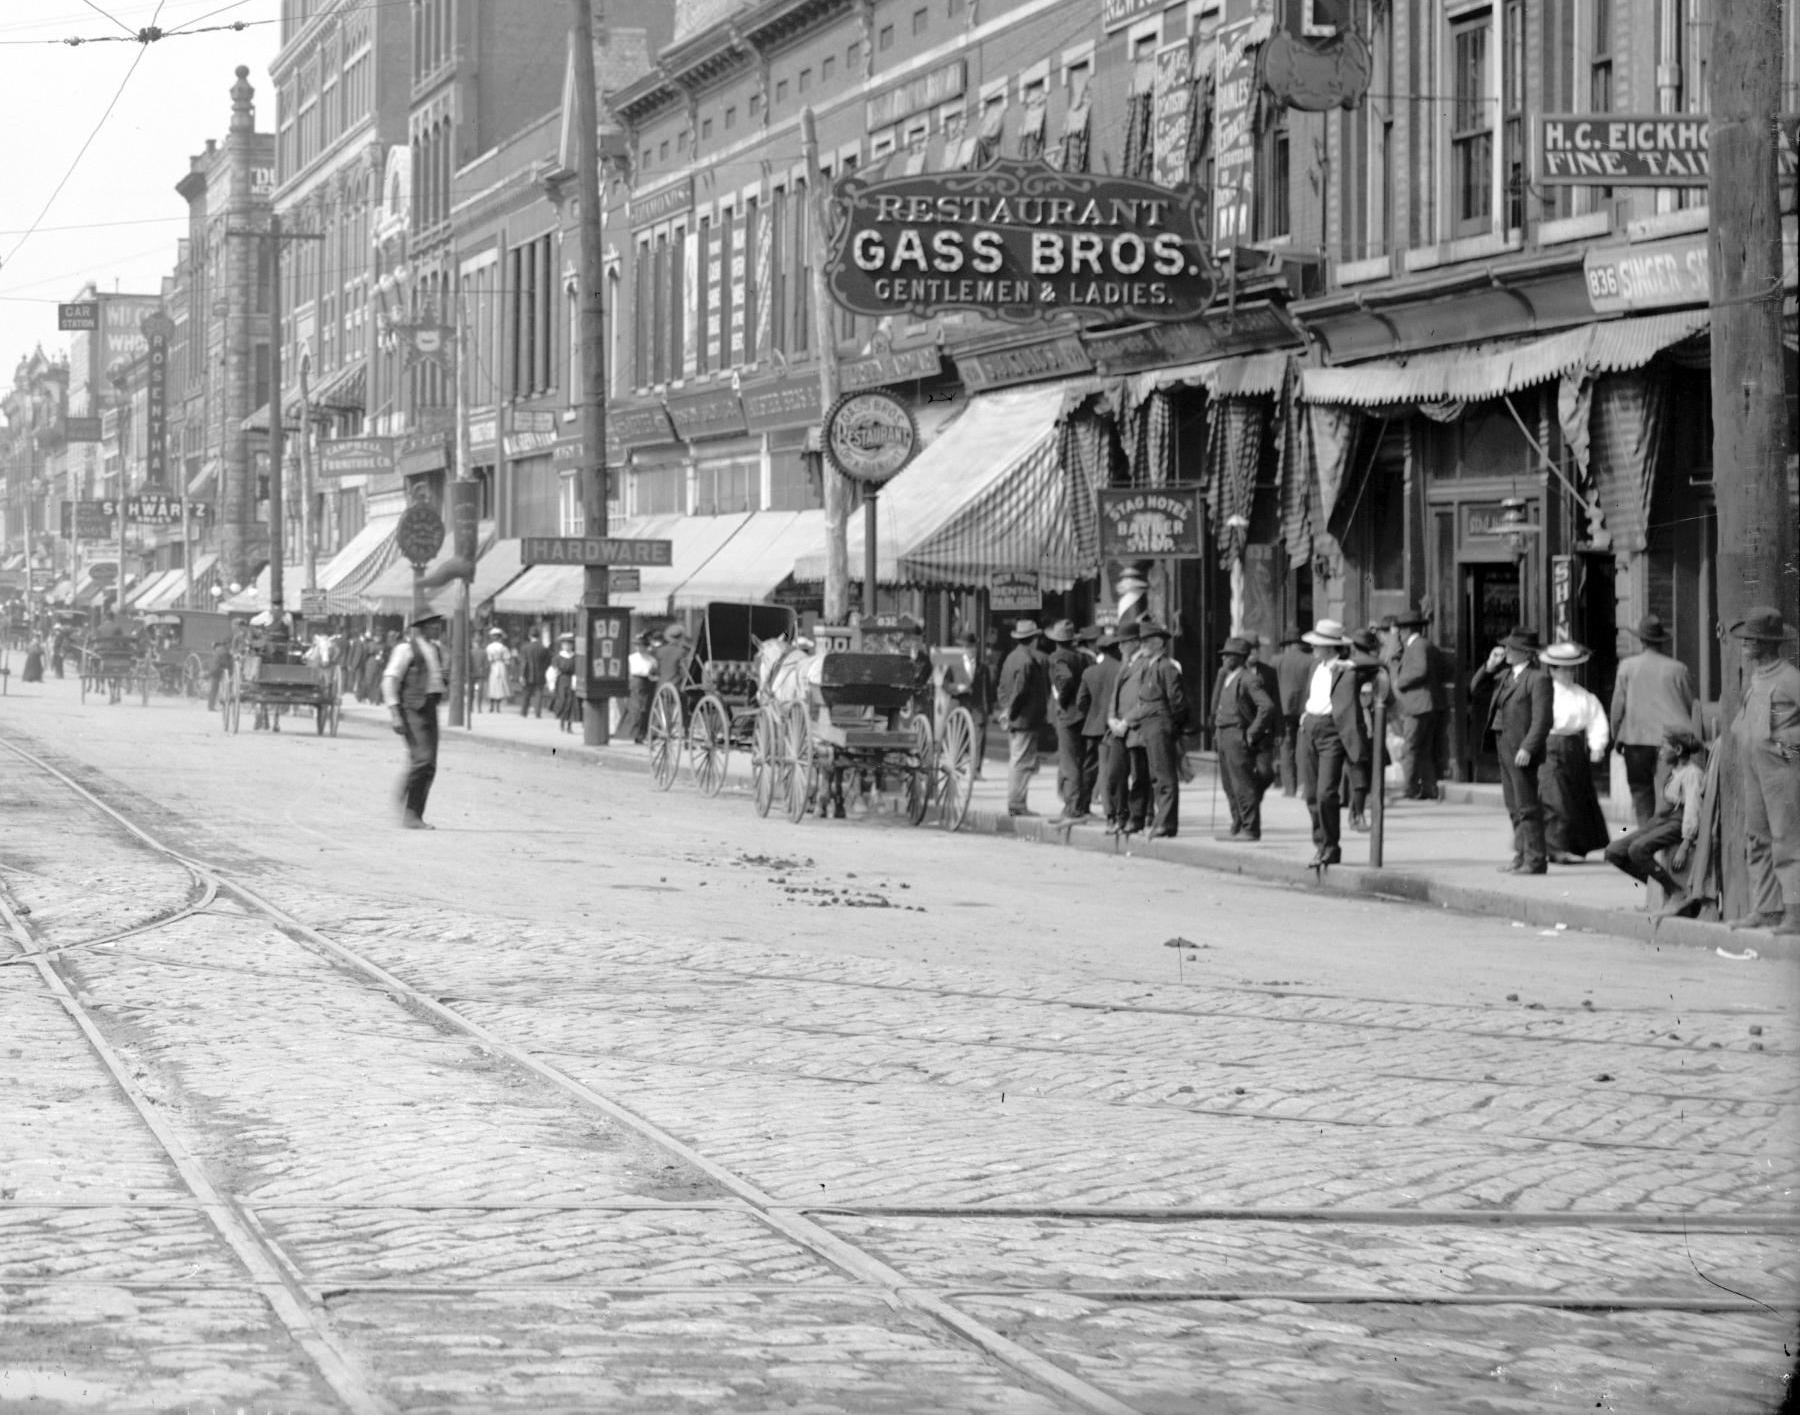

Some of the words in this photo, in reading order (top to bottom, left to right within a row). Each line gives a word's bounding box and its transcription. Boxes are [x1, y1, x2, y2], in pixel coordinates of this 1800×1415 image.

[1545, 151, 1628, 176] FINE
[875, 193, 1168, 226] RESTAURANT
[853, 228, 1004, 274] GASS
[1030, 231, 1199, 276] BROS.
[1588, 266, 1618, 298] 836
[1618, 253, 1681, 301] SINGER
[874, 278, 1029, 302] GENTLEMEN
[1039, 282, 1057, 303] &
[1069, 282, 1175, 305] LADIES.
[64, 305, 91, 317] CAR
[151, 335, 165, 487] ROSENTHAL
[1109, 495, 1145, 523] STAG
[1146, 495, 1189, 522] HOTEL
[533, 540, 668, 564] HARDWARE
[991, 586, 1039, 596] DENTAL
[1554, 561, 1570, 645] SHIN
